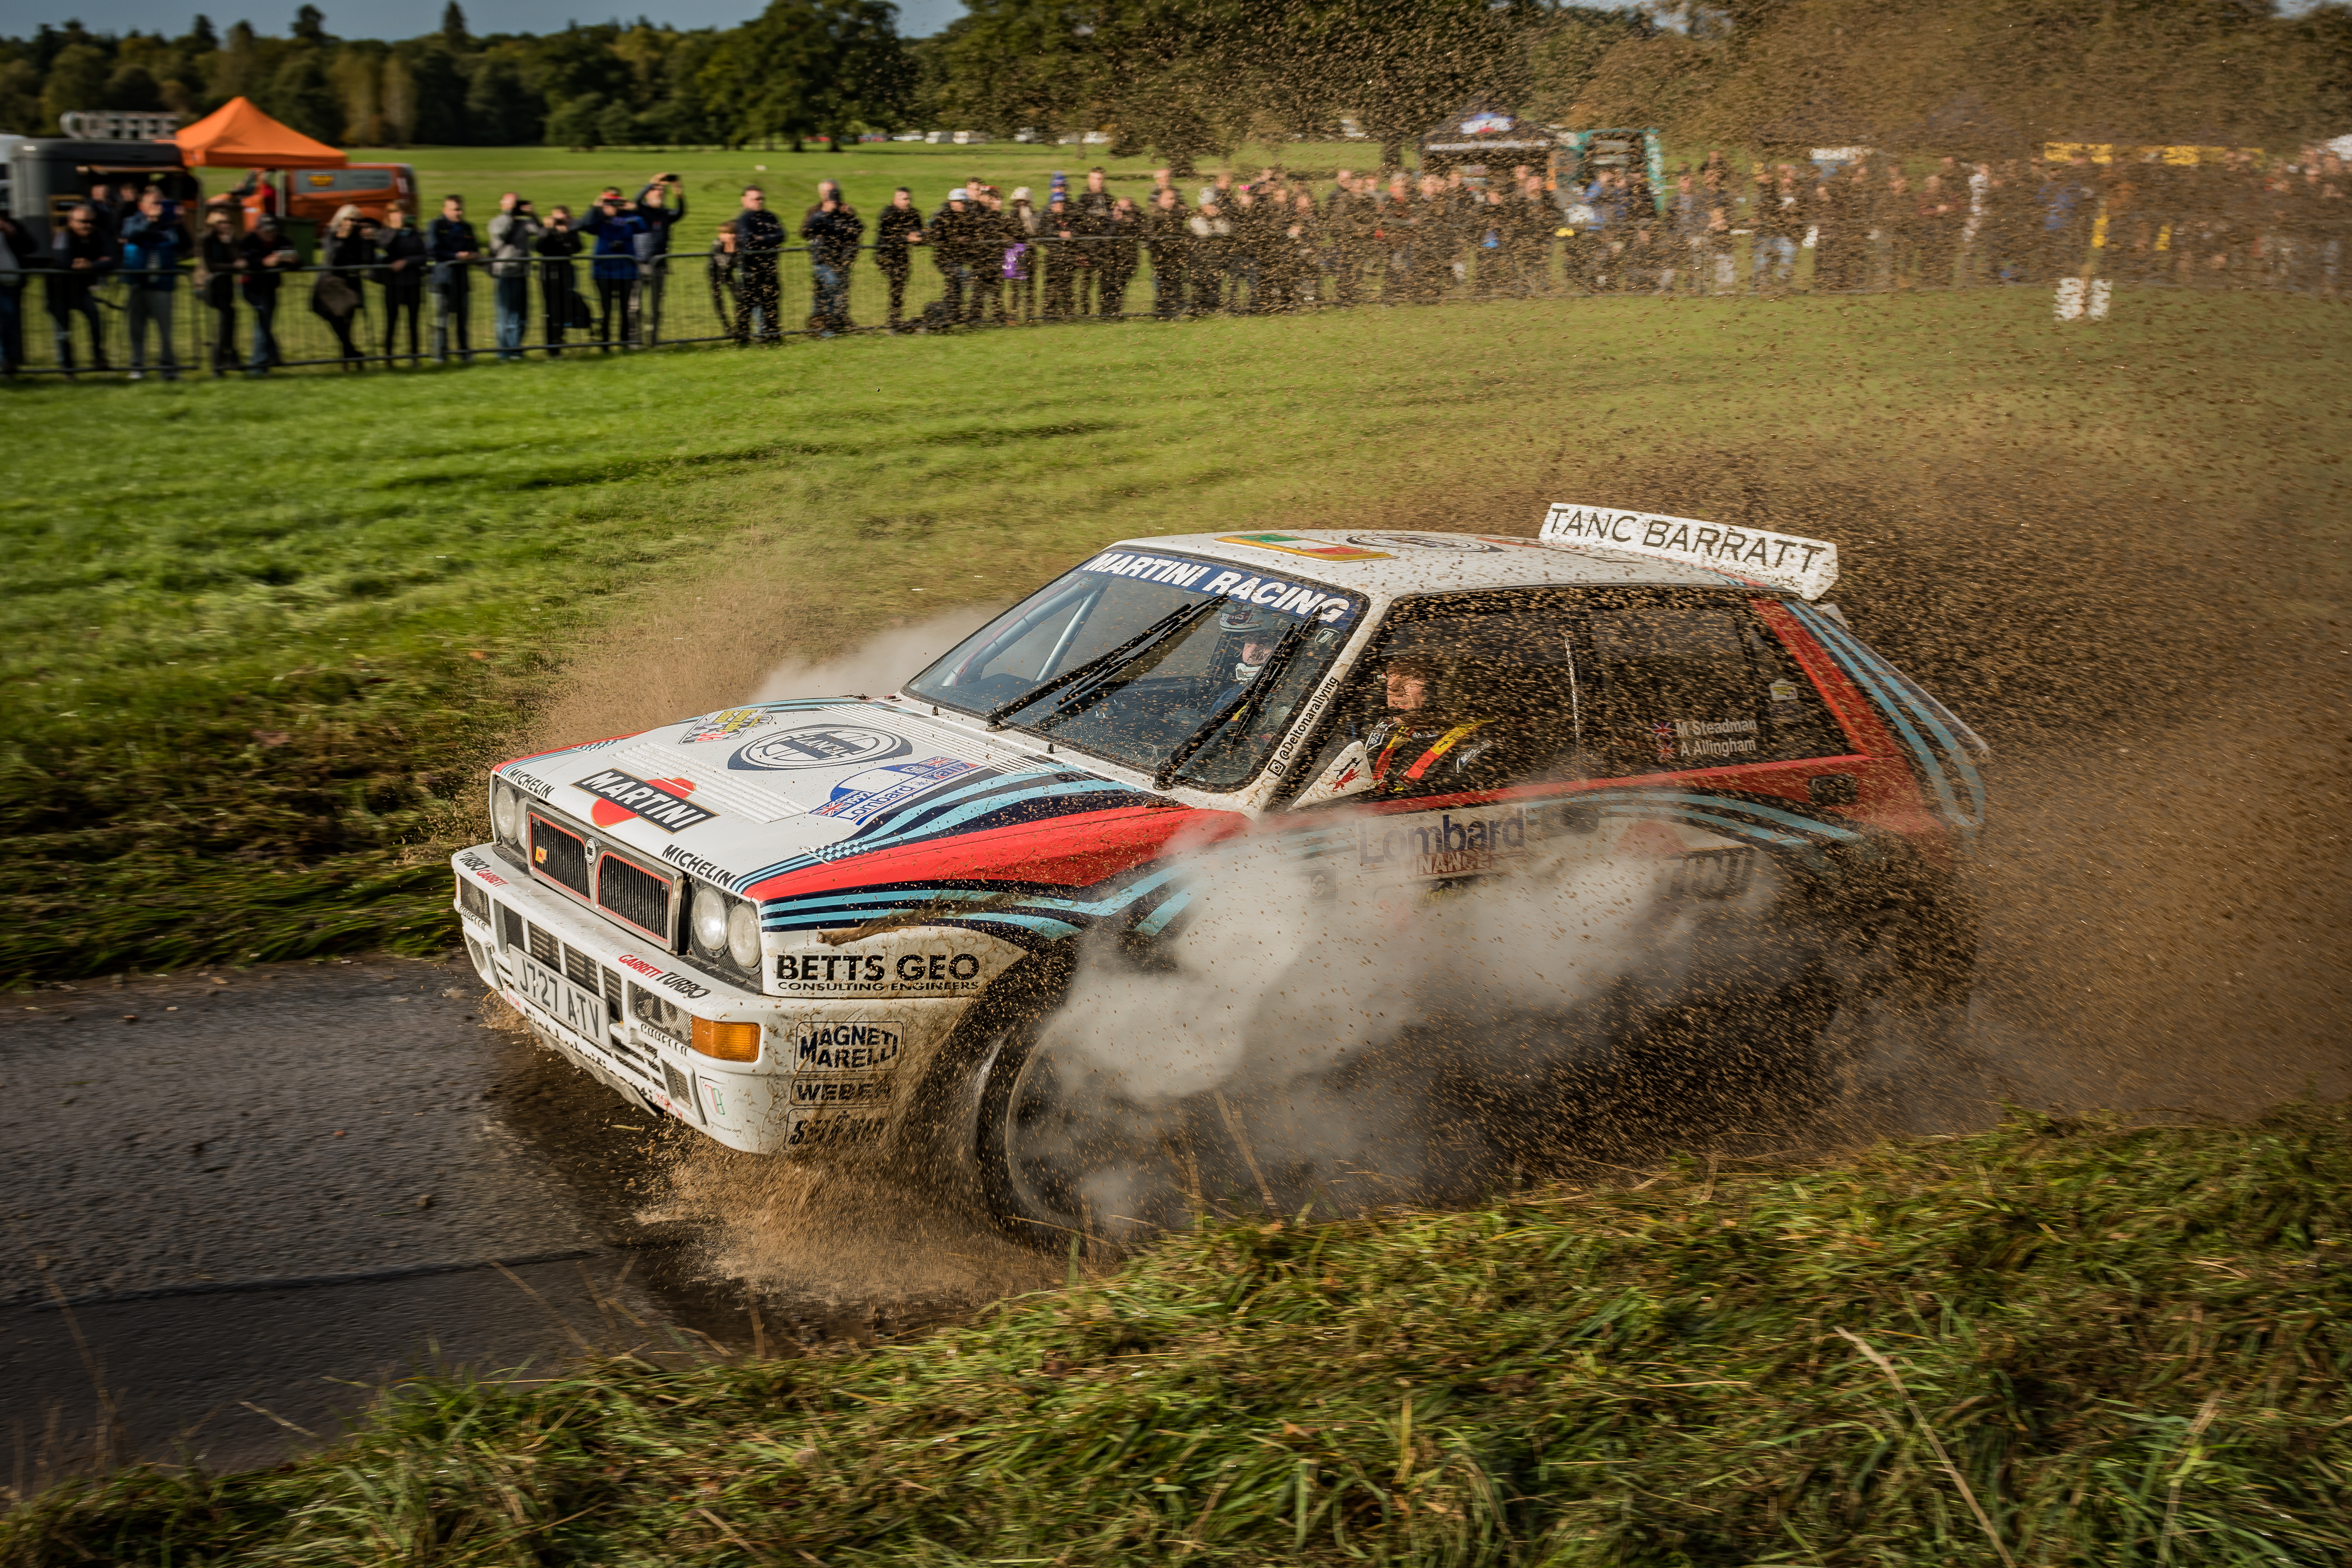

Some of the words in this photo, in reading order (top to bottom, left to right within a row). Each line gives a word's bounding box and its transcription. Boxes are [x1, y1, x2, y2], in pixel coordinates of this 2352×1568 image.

[1552, 508, 1637, 542] TANC
[1643, 520, 1826, 573] BARRATT
[1082, 553, 1211, 588] MARTINI
[1205, 571, 1350, 623] RACING
[1279, 676, 1340, 760] @Deltonarallying
[1691, 718, 1758, 735] Steadman
[793, 736, 849, 756] LANCIA
[1680, 741, 1690, 757] A
[507, 768, 555, 798] MICHELIN
[581, 771, 707, 829] MARTINI
[842, 792, 875, 805] 1992
[836, 785, 916, 820] Lombard
[1359, 807, 1525, 865] Lombard
[459, 851, 491, 871] TURBO
[476, 869, 509, 887] GARRETT
[662, 844, 733, 887] MICHELIN
[618, 954, 664, 978] GARRETT
[655, 972, 712, 999] TURBO
[776, 955, 885, 981] BETTS
[896, 953, 980, 981] GEO
[520, 958, 558, 1013] J727
[567, 986, 599, 1039] ATV
[778, 982, 885, 991] CONSULTING
[891, 981, 979, 991] ENGINEERS
[800, 1025, 898, 1051] MAGNETI
[800, 1046, 898, 1068] MARELLI
